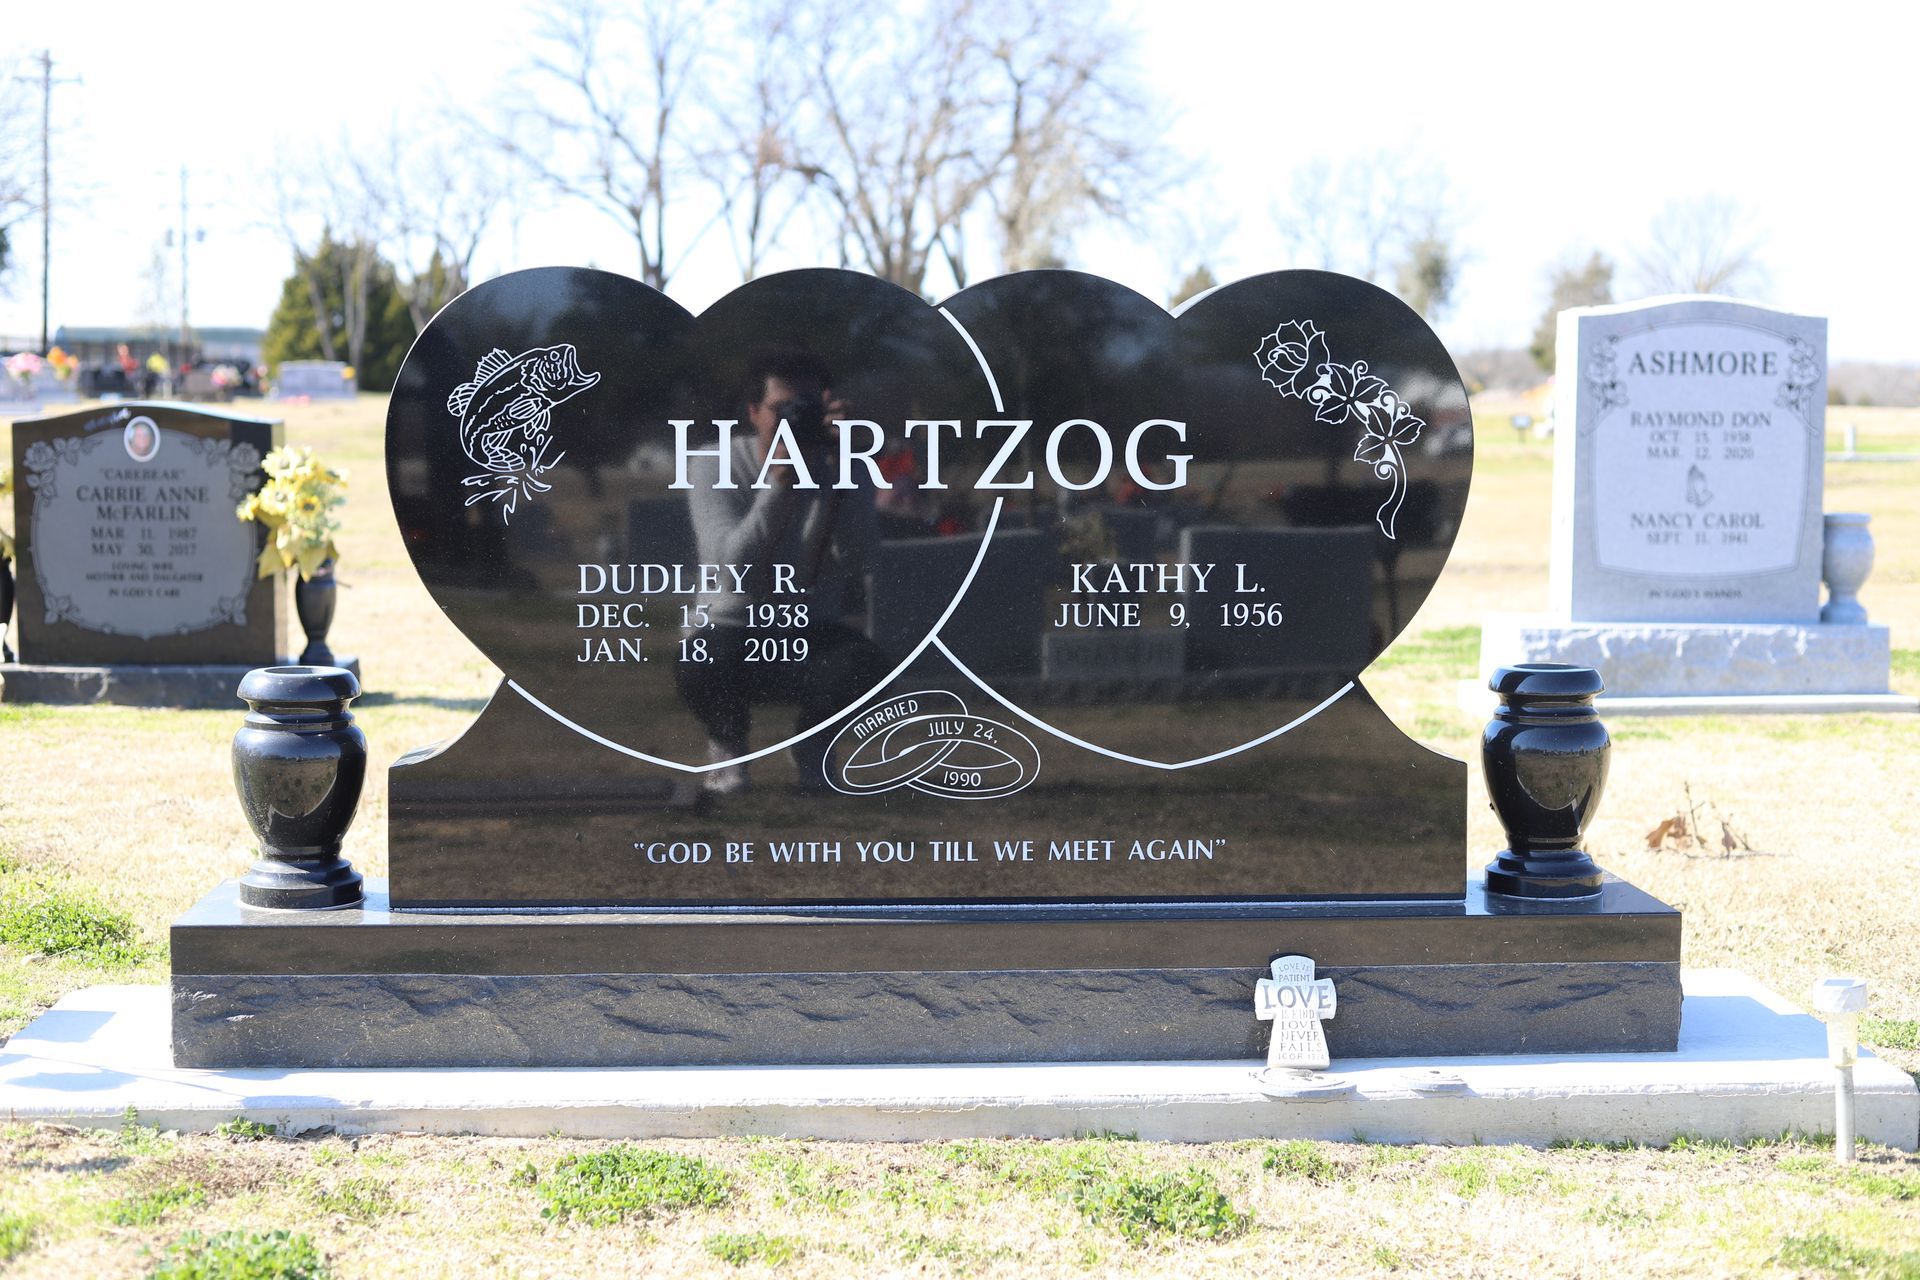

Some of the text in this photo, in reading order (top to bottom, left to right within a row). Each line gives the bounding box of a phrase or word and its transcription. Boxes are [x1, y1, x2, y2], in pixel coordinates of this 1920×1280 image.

[1629, 350, 1778, 376] ASHMORE
[1630, 411, 1772, 428] RAYMOND DON
[668, 419, 1194, 491] HARTZOG
[76, 485, 209, 503] CARRIE ANNE
[96, 504, 190, 521] McFARLIN
[1630, 511, 1765, 530] NANCY CAROL
[91, 542, 123, 556] MAY
[578, 564, 806, 594] DUDLEY R.
[1071, 563, 1266, 593] KATHY L.
[577, 603, 809, 632] DEC. 15, 1938
[1055, 603, 1283, 631] JUNE 9, 1956
[577, 637, 809, 666] JAN. 18, 2019
[853, 699, 919, 740] MARRIED
[928, 721, 998, 744] JULY 24,
[943, 770, 982, 787] 1990
[633, 839, 1227, 865] "GOD BE WITH YOU TILL WE MEET AGAIN"
[1279, 963, 1300, 973] LOVE
[1279, 974, 1311, 982] PATIENT
[1263, 985, 1332, 1010] LOVE
[1281, 1021, 1317, 1030] LOVE
[1281, 1031, 1321, 1041] NEVER
[1280, 1042, 1323, 1051] FAILS
